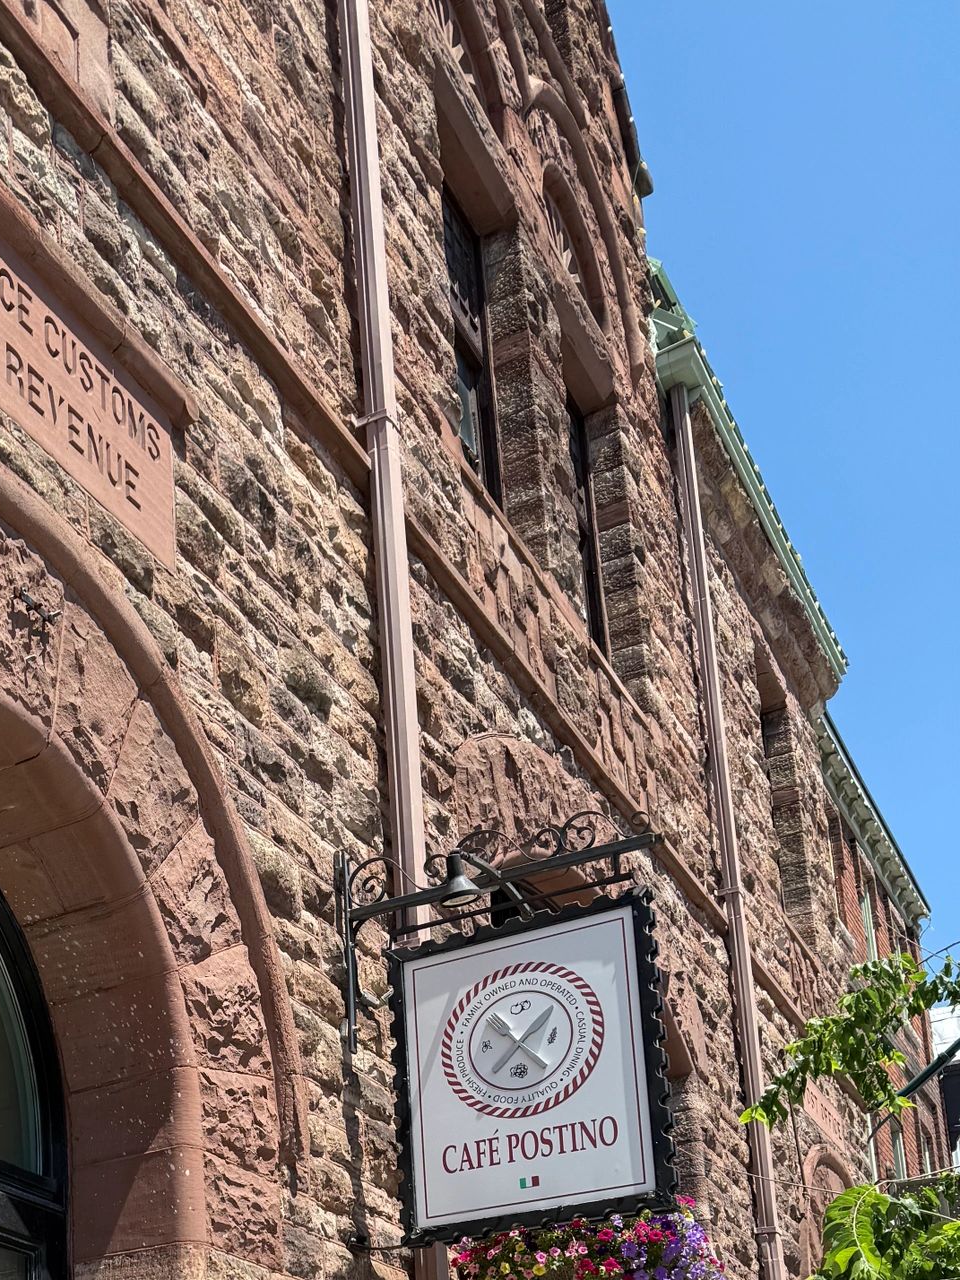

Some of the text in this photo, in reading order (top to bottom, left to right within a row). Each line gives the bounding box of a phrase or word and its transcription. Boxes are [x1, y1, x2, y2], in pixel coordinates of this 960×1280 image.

[43, 314, 161, 464] CUSTOMS
[5, 341, 141, 511] REVENUE
[462, 977, 578, 1027] FAMILY OWNED AND OPERATED
[455, 1039, 488, 1098] FRESH PRODUCE
[561, 1011, 587, 1077] CASUAL DINING
[493, 1081, 558, 1105] QUALITY FOOD
[442, 1115, 619, 1174] CAFÉ POSTINO
